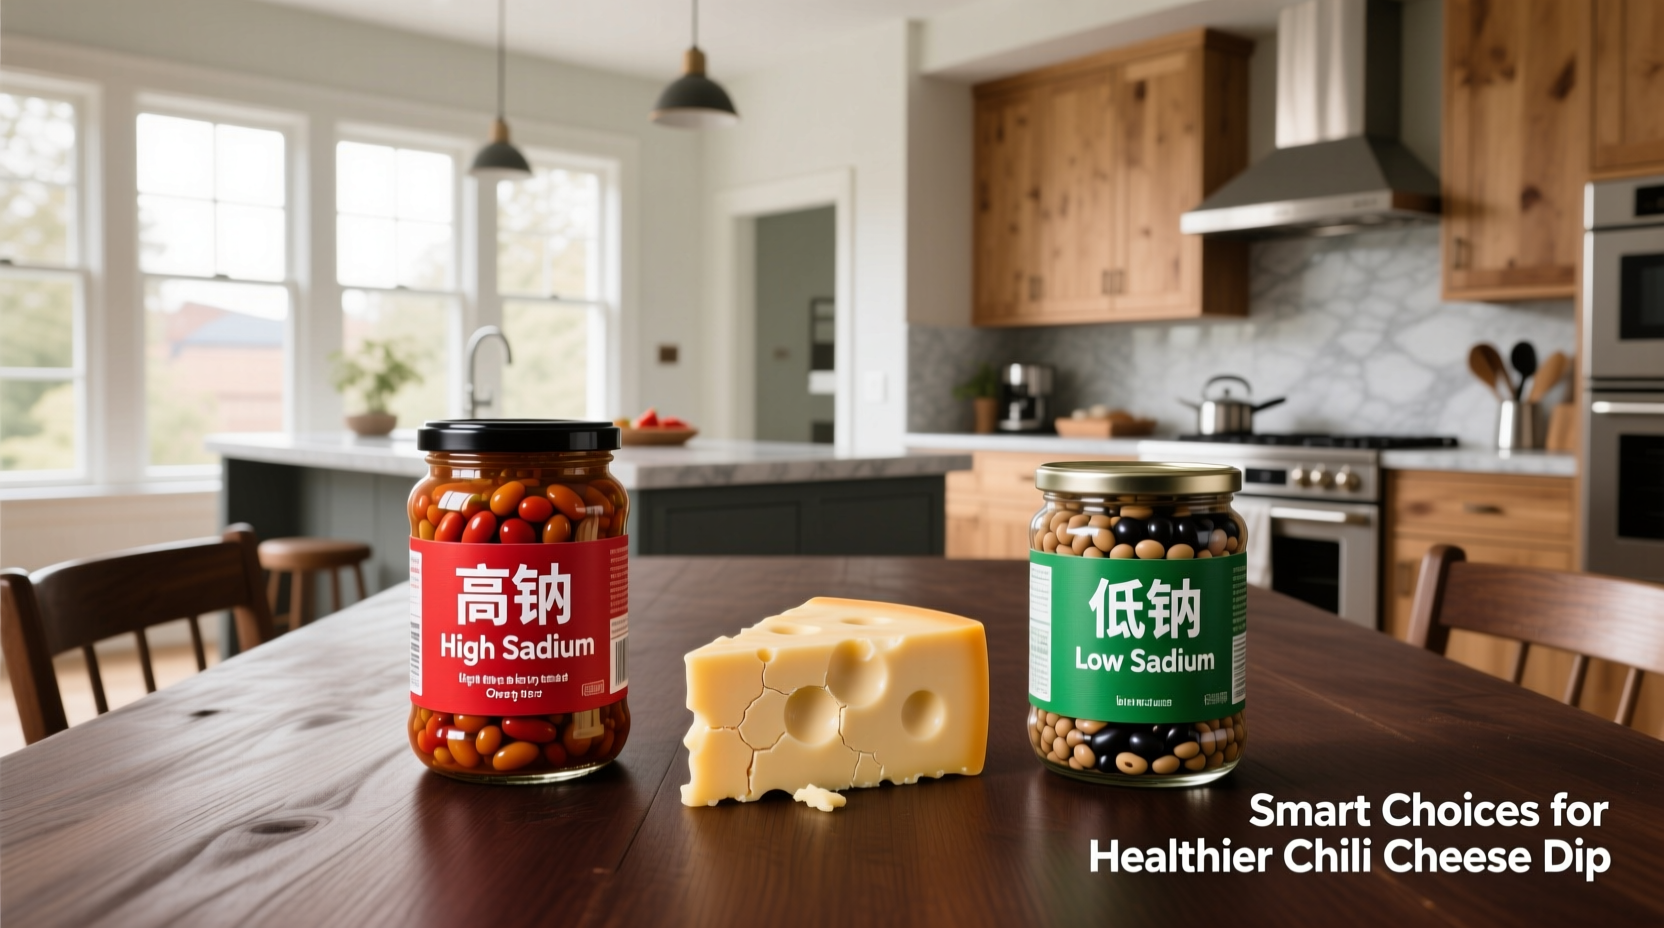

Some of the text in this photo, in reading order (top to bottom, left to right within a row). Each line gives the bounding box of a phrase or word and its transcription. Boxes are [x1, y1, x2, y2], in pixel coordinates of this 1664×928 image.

[456, 562, 571, 626] 高钠
[1088, 577, 1201, 639] 低钠
[441, 633, 595, 666] High Sadium
[1075, 646, 1215, 673] Low Sadium
